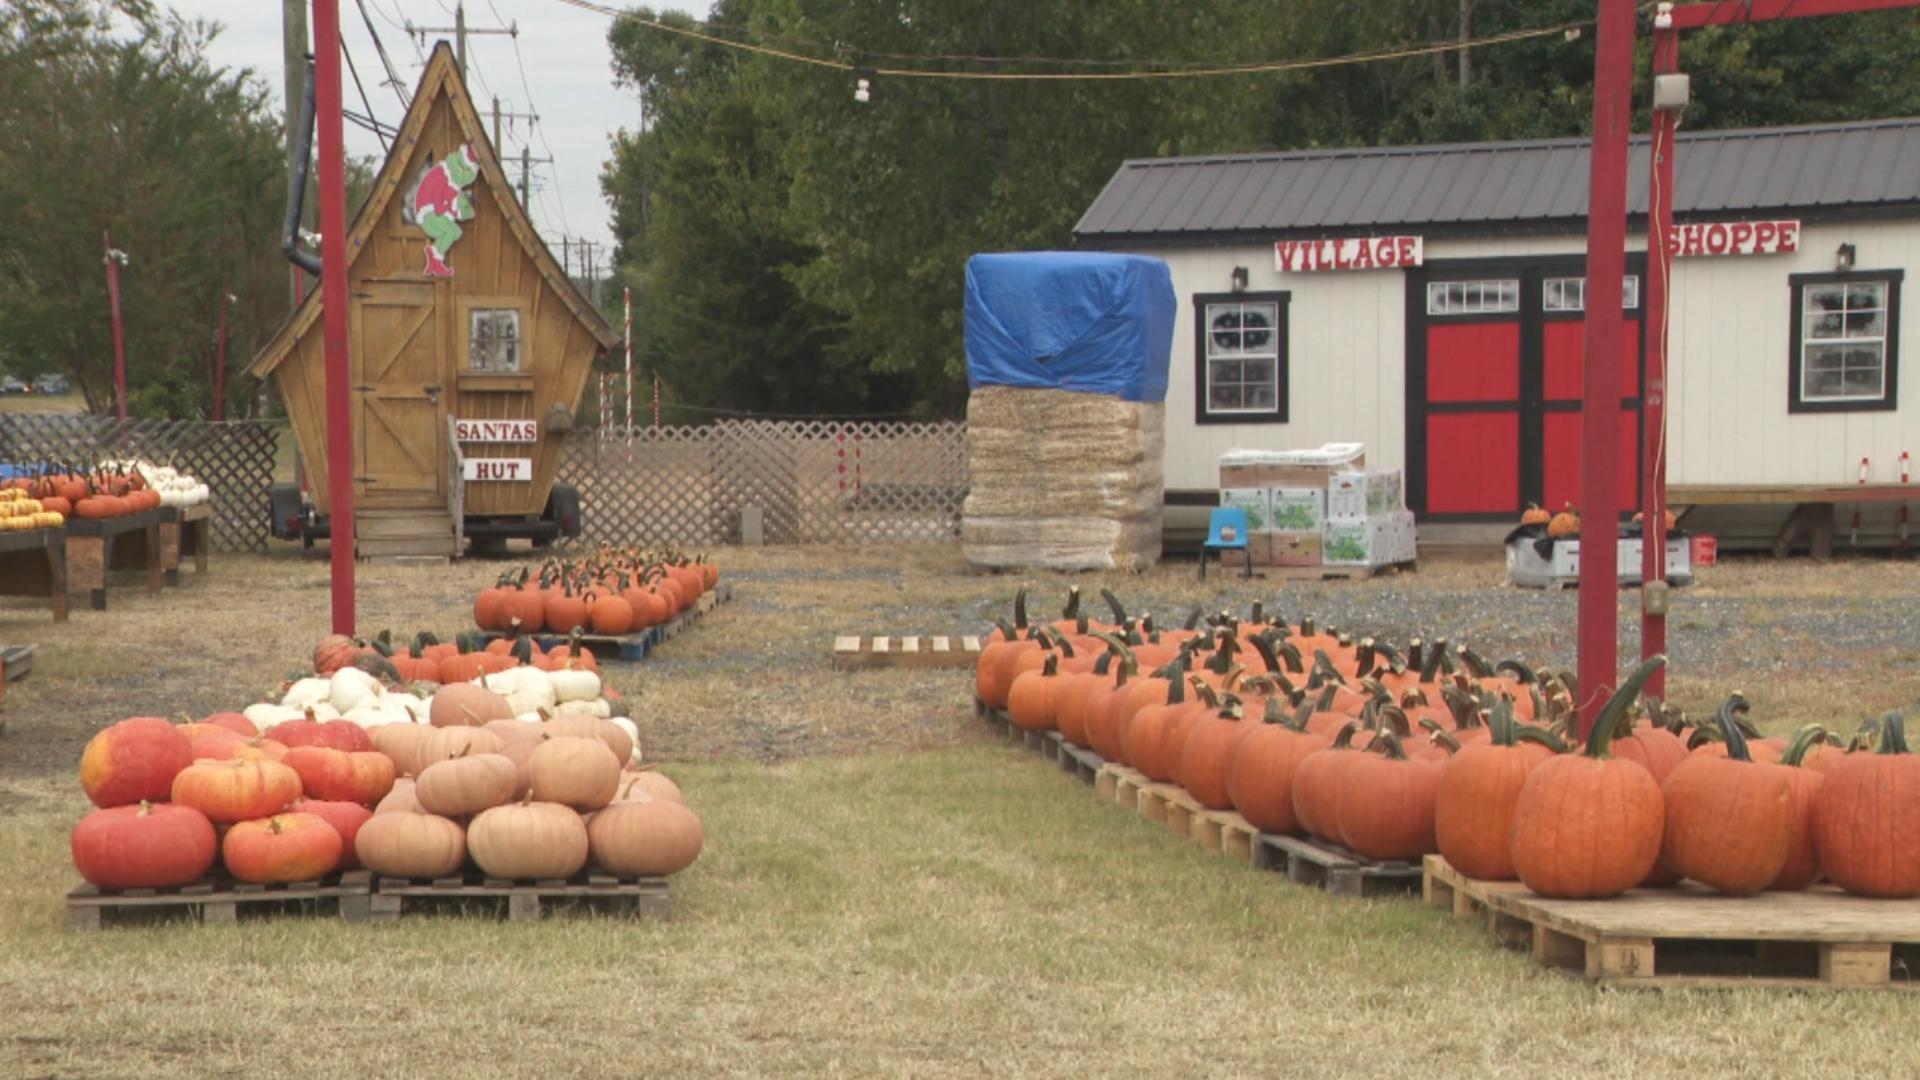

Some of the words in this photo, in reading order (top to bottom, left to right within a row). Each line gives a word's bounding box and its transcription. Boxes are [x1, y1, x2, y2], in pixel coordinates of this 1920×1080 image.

[1669, 222, 1797, 255] SHOPPE
[1277, 236, 1415, 271] VILLAGE
[457, 423, 536, 439] SANTAS
[476, 462, 519, 479] HUT
